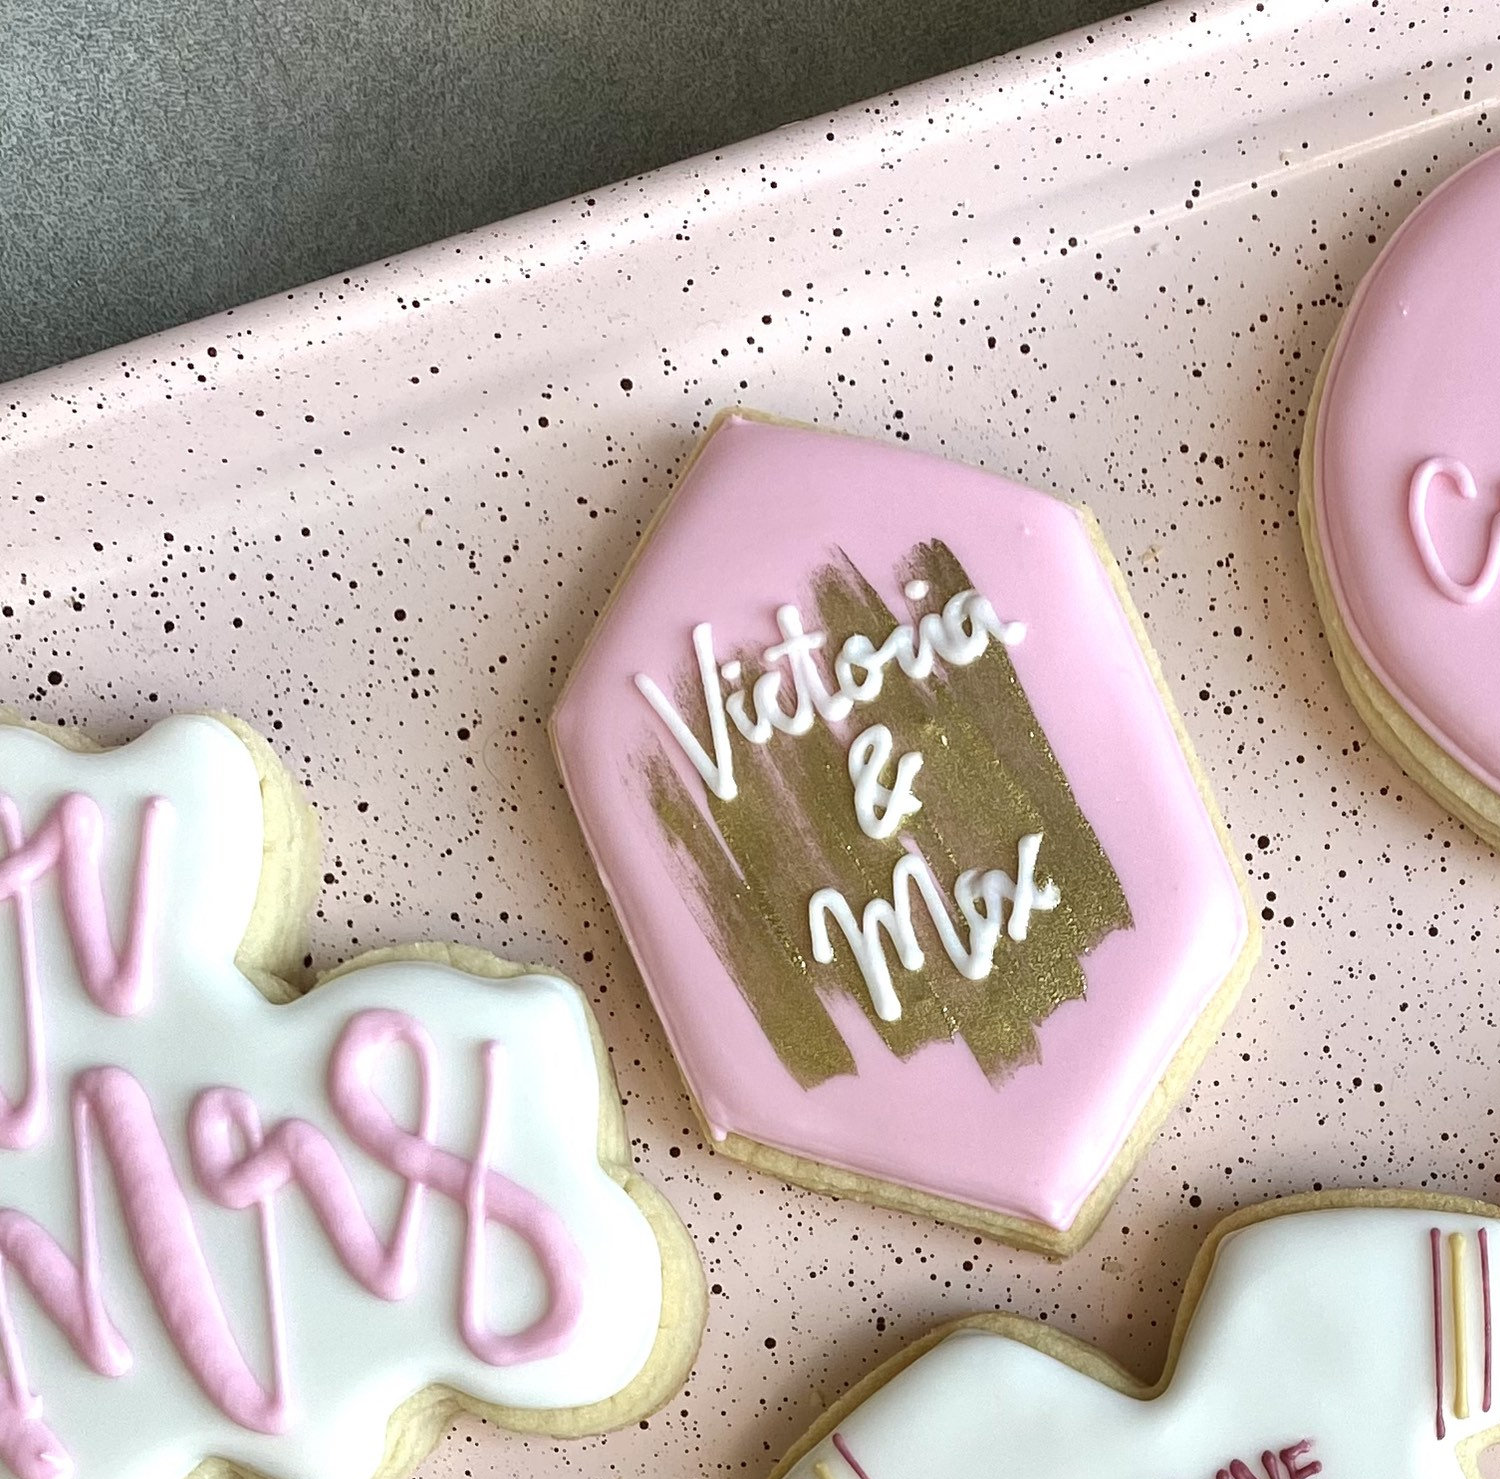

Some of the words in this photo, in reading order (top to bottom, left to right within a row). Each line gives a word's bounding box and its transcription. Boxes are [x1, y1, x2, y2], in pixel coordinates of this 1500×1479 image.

[635, 579, 1027, 800] Victoria
[848, 724, 924, 840] &
[808, 832, 1061, 1022] Max
